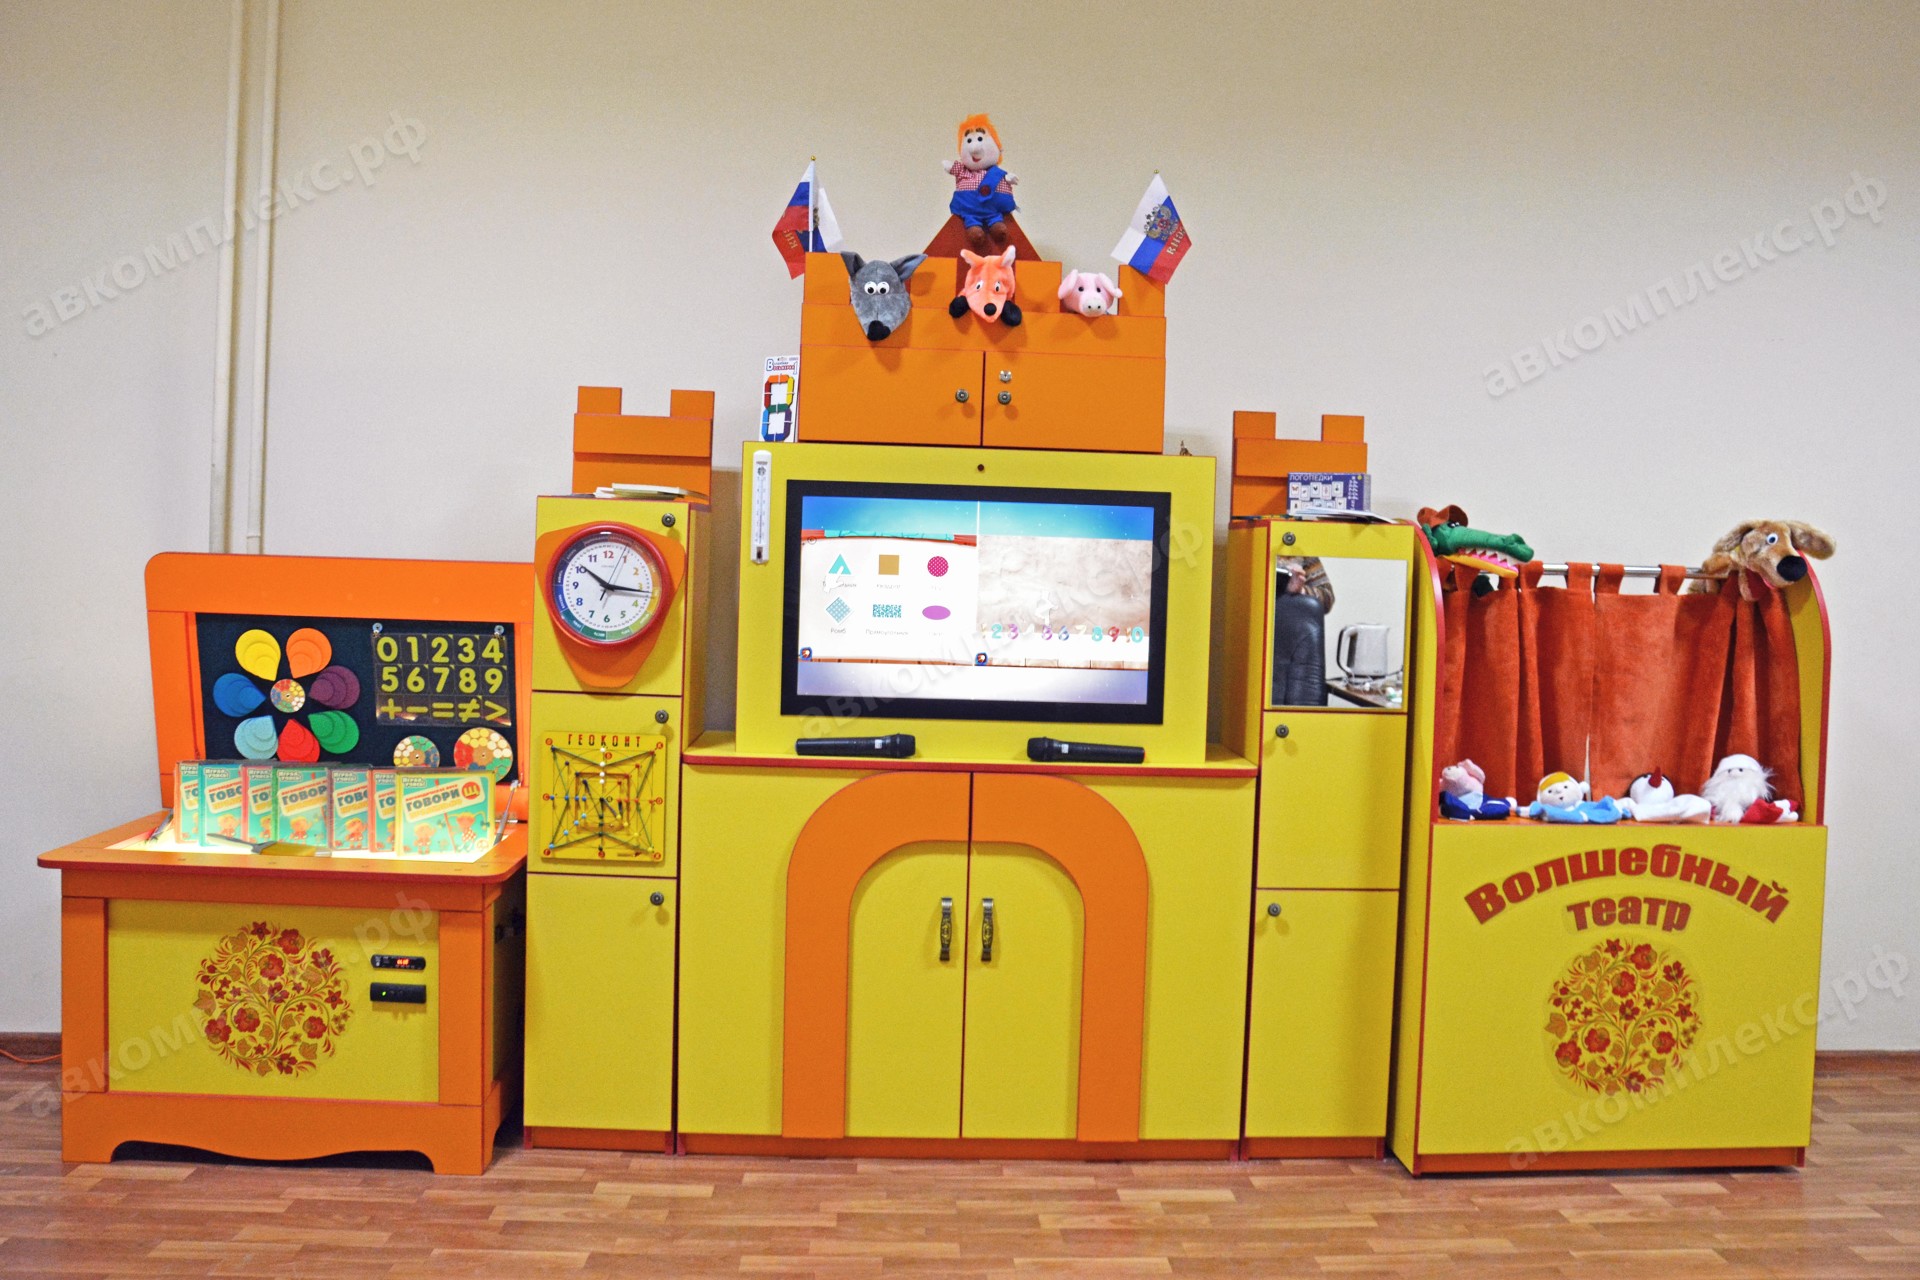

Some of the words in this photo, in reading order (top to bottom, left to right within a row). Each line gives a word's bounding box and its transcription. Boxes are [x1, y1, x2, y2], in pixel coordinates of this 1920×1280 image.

[575, 566, 587, 574] 10
[632, 600, 639, 608] 4
[568, 733, 641, 747] ГЕОКОНТ
[282, 785, 327, 805] ГОВОР
[406, 789, 460, 812] ГОВОРИ
[1464, 844, 1789, 925] Волшебный
[1566, 896, 1692, 932] театр
